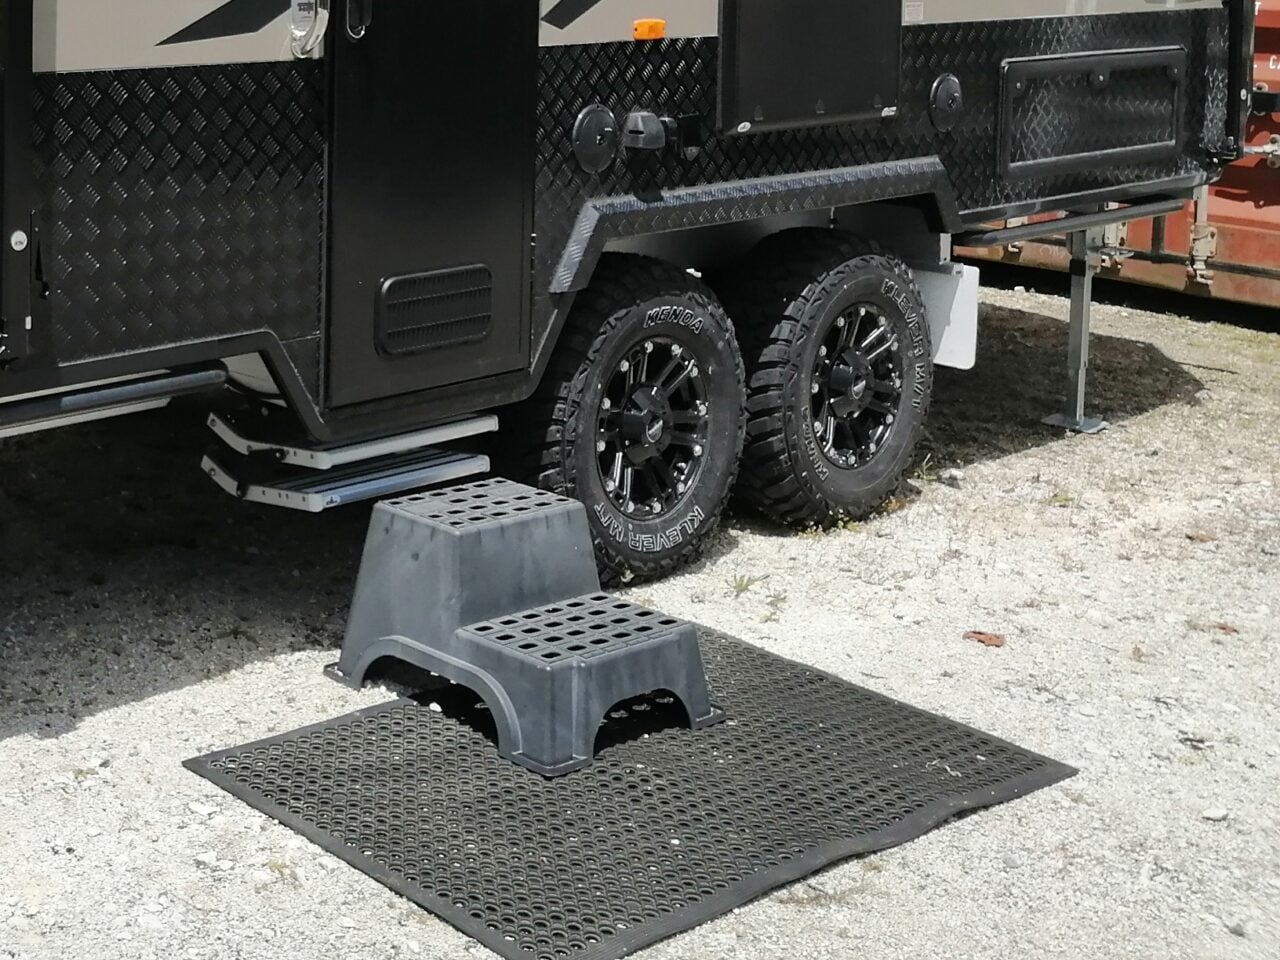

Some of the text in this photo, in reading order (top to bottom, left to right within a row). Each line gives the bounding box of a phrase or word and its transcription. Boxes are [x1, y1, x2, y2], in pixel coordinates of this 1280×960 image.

[643, 305, 704, 334] KENDA
[594, 502, 704, 552] KLEVER M/T
